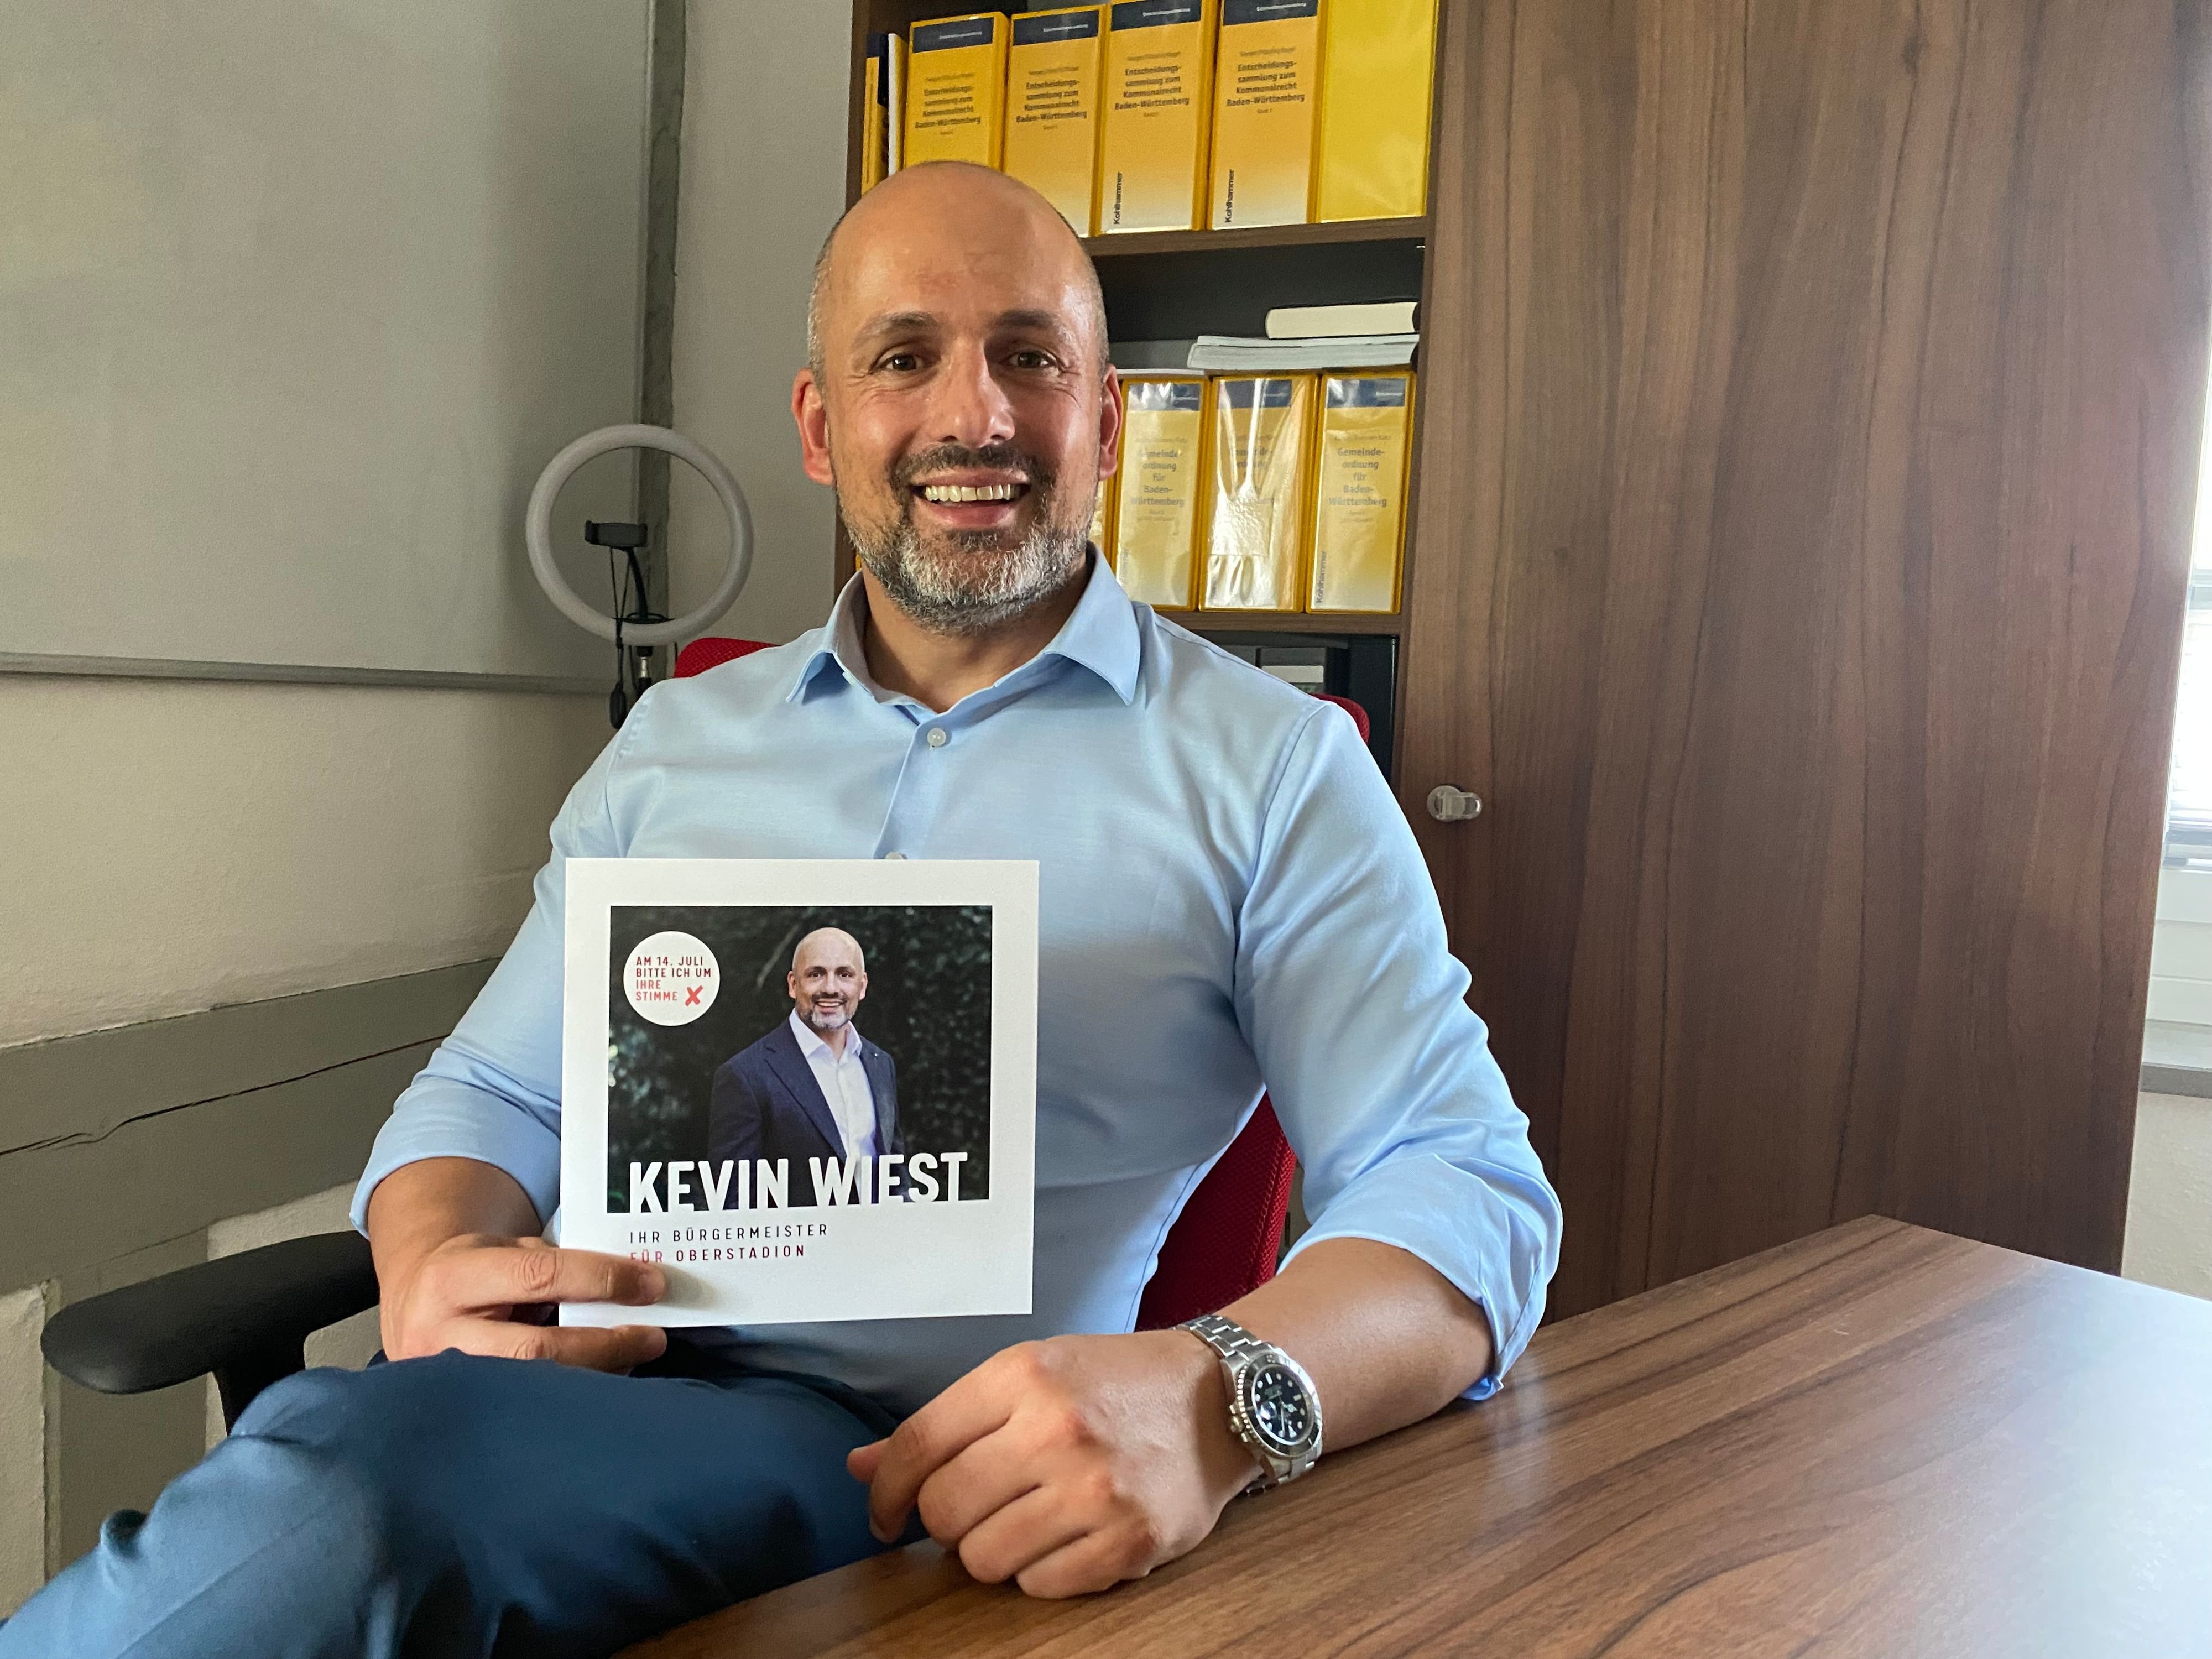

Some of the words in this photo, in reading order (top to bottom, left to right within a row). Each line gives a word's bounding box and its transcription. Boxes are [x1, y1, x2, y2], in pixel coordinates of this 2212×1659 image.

[1238, 61, 1297, 71] Entscheidungs-
[1238, 74, 1277, 83] sammlung
[1237, 82, 1297, 94] Kommunalrecht
[1227, 93, 1305, 106] Baden-Württemberg
[1113, 171, 1123, 224] Kohlhammer
[1224, 169, 1234, 223] Kohlhammer
[1338, 448, 1385, 456] Gemeinde-
[1342, 461, 1379, 470] ordnung
[1353, 472, 1366, 481] für
[1344, 484, 1374, 493] Baden-
[1329, 497, 1387, 508] Württemberg
[1316, 550, 1327, 603] Kohlhammer
[636, 956, 651, 966] AM
[656, 956, 673, 966] 14.
[679, 956, 703, 966] JULI
[636, 968, 666, 977] BITTE
[672, 968, 690, 977] ICH
[696, 968, 711, 977] UM
[636, 980, 661, 989] IHRE
[635, 992, 678, 1001] STIMME
[629, 1157, 789, 1213] KEVIN
[808, 1151, 968, 1206] WIEST
[630, 1231, 660, 1244] IHR
[673, 1224, 828, 1242] BÜRGERMEISTER
[630, 1249, 663, 1263] FÜR
[676, 1245, 805, 1262] OBERSTADION
